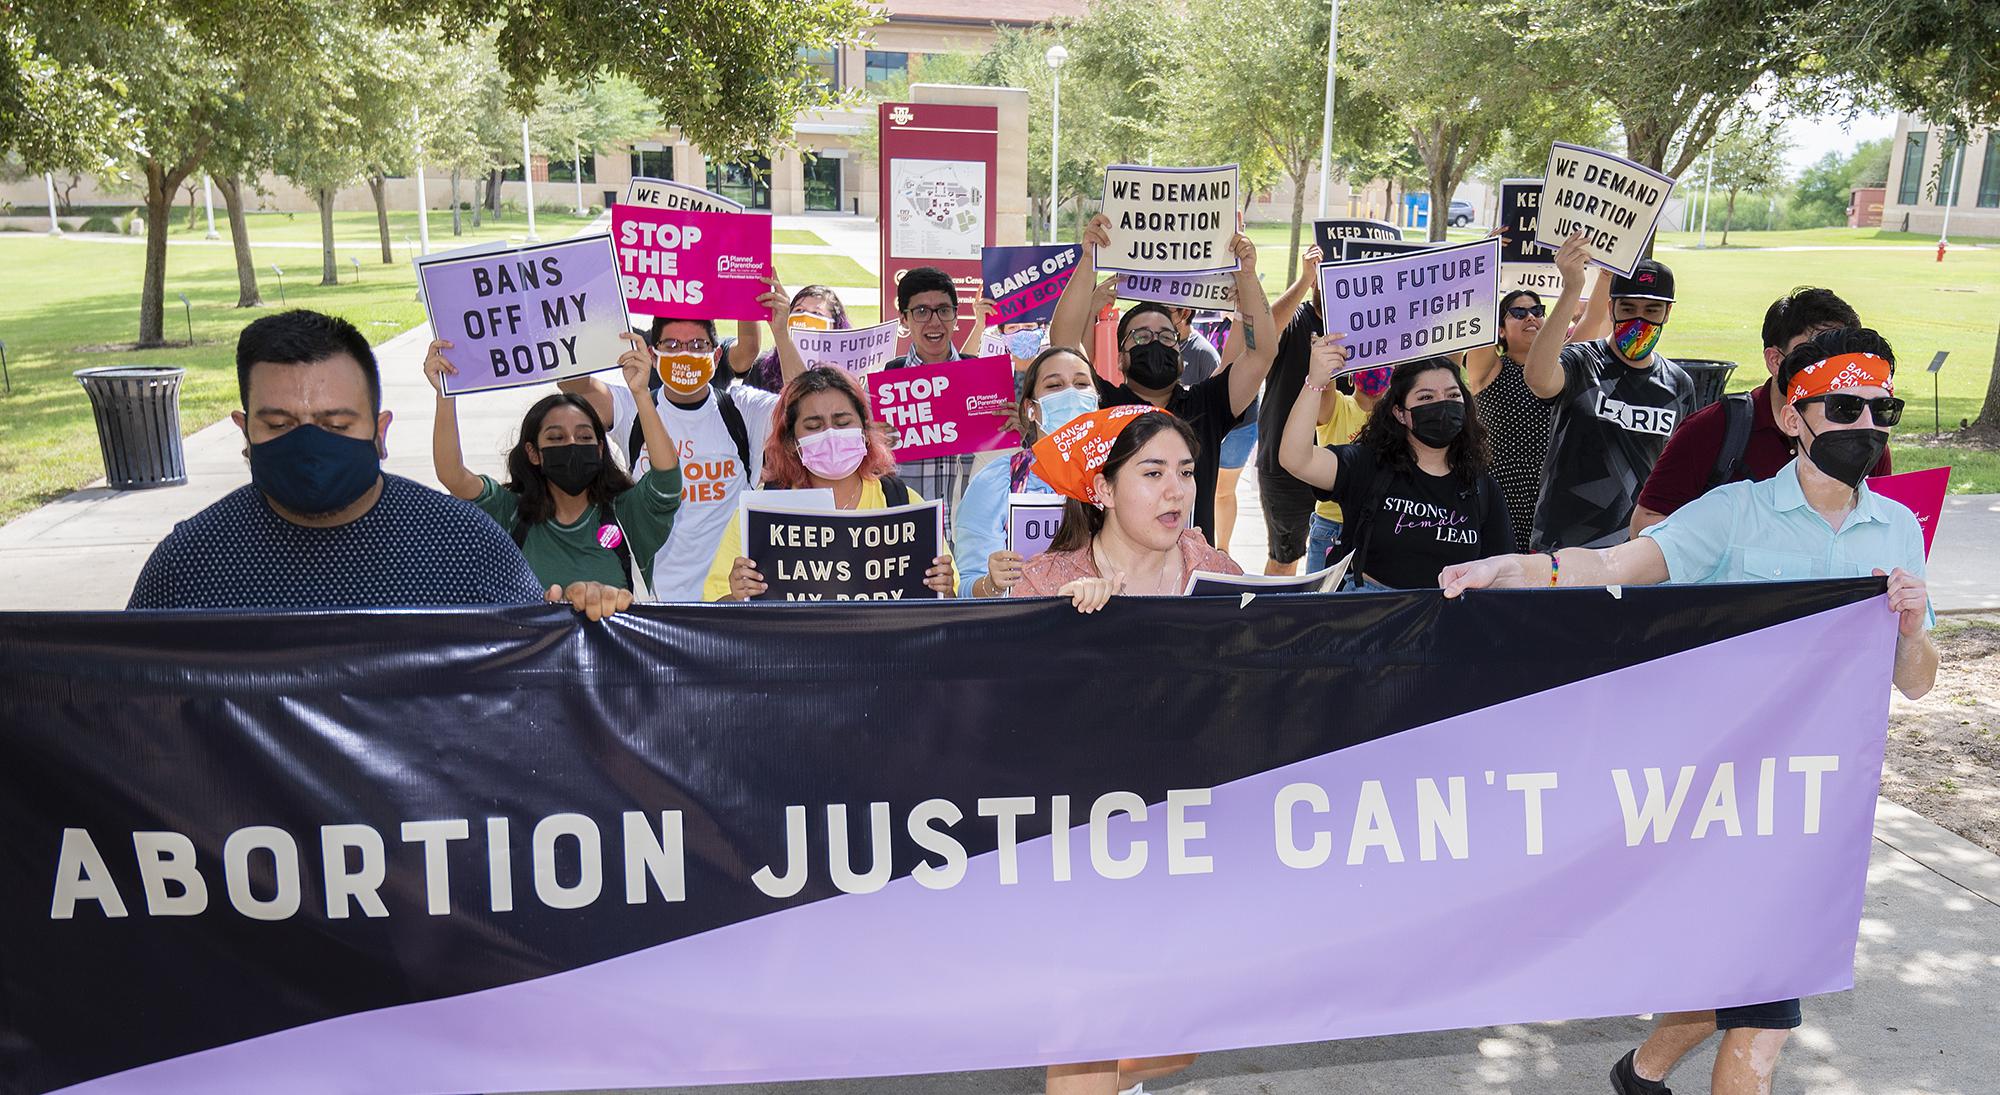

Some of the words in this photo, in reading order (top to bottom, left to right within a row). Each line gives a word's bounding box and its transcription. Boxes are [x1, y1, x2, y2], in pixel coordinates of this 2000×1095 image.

[1112, 181, 1140, 200] WE
[1152, 181, 1230, 201] DEMAND
[1555, 158, 1579, 178] WE
[1584, 164, 1659, 207] DEMAND
[637, 188, 660, 204] WE
[1555, 188, 1637, 230] ABORTION
[1120, 211, 1221, 231] ABORTION
[1327, 227, 1361, 240] KEEP
[621, 220, 702, 250] STOP
[620, 248, 678, 276] THE
[1128, 241, 1212, 260] JUSTICE
[472, 257, 563, 297] BANS
[990, 265, 1040, 299] BANS
[1042, 248, 1075, 274] OFF
[1336, 275, 1384, 299] OUR
[1397, 256, 1485, 291] FUTURE
[1518, 273, 1565, 288] JUSTI
[622, 275, 704, 305] BANS
[1000, 295, 1027, 317] MY
[1032, 273, 1072, 302] BOD
[1127, 275, 1162, 293] OUR
[1170, 280, 1229, 301] BODIES
[464, 304, 521, 340] OFF
[541, 292, 588, 328] MY
[1350, 306, 1396, 331] OUR
[1409, 289, 1474, 319] FIGHT
[800, 338, 831, 353] OUR
[840, 331, 891, 352] FUTURE
[1345, 338, 1388, 361] OUR
[1400, 318, 1481, 351] BODIES
[490, 336, 578, 377] BODY
[672, 362, 691, 372] BANS
[847, 352, 884, 370] FIGHT
[671, 375, 698, 385] BODIES
[672, 369, 686, 377] OFF
[686, 369, 702, 378] OUR
[878, 376, 950, 405] STOP
[977, 393, 998, 401] Planned
[880, 402, 934, 428] THE
[684, 459, 736, 481] OUR
[769, 524, 835, 548] KEEP
[848, 521, 916, 548] YOUR
[1025, 520, 1060, 540] OU
[1395, 510, 1468, 534] female
[1436, 527, 1478, 544] LEAD
[777, 560, 851, 581] LAWS
[865, 555, 911, 580] OFF
[50, 809, 686, 921] ABORTION
[750, 788, 1214, 898] JUSTICE
[1273, 770, 1558, 869] CAN'T
[1611, 755, 1840, 848] WAIT
